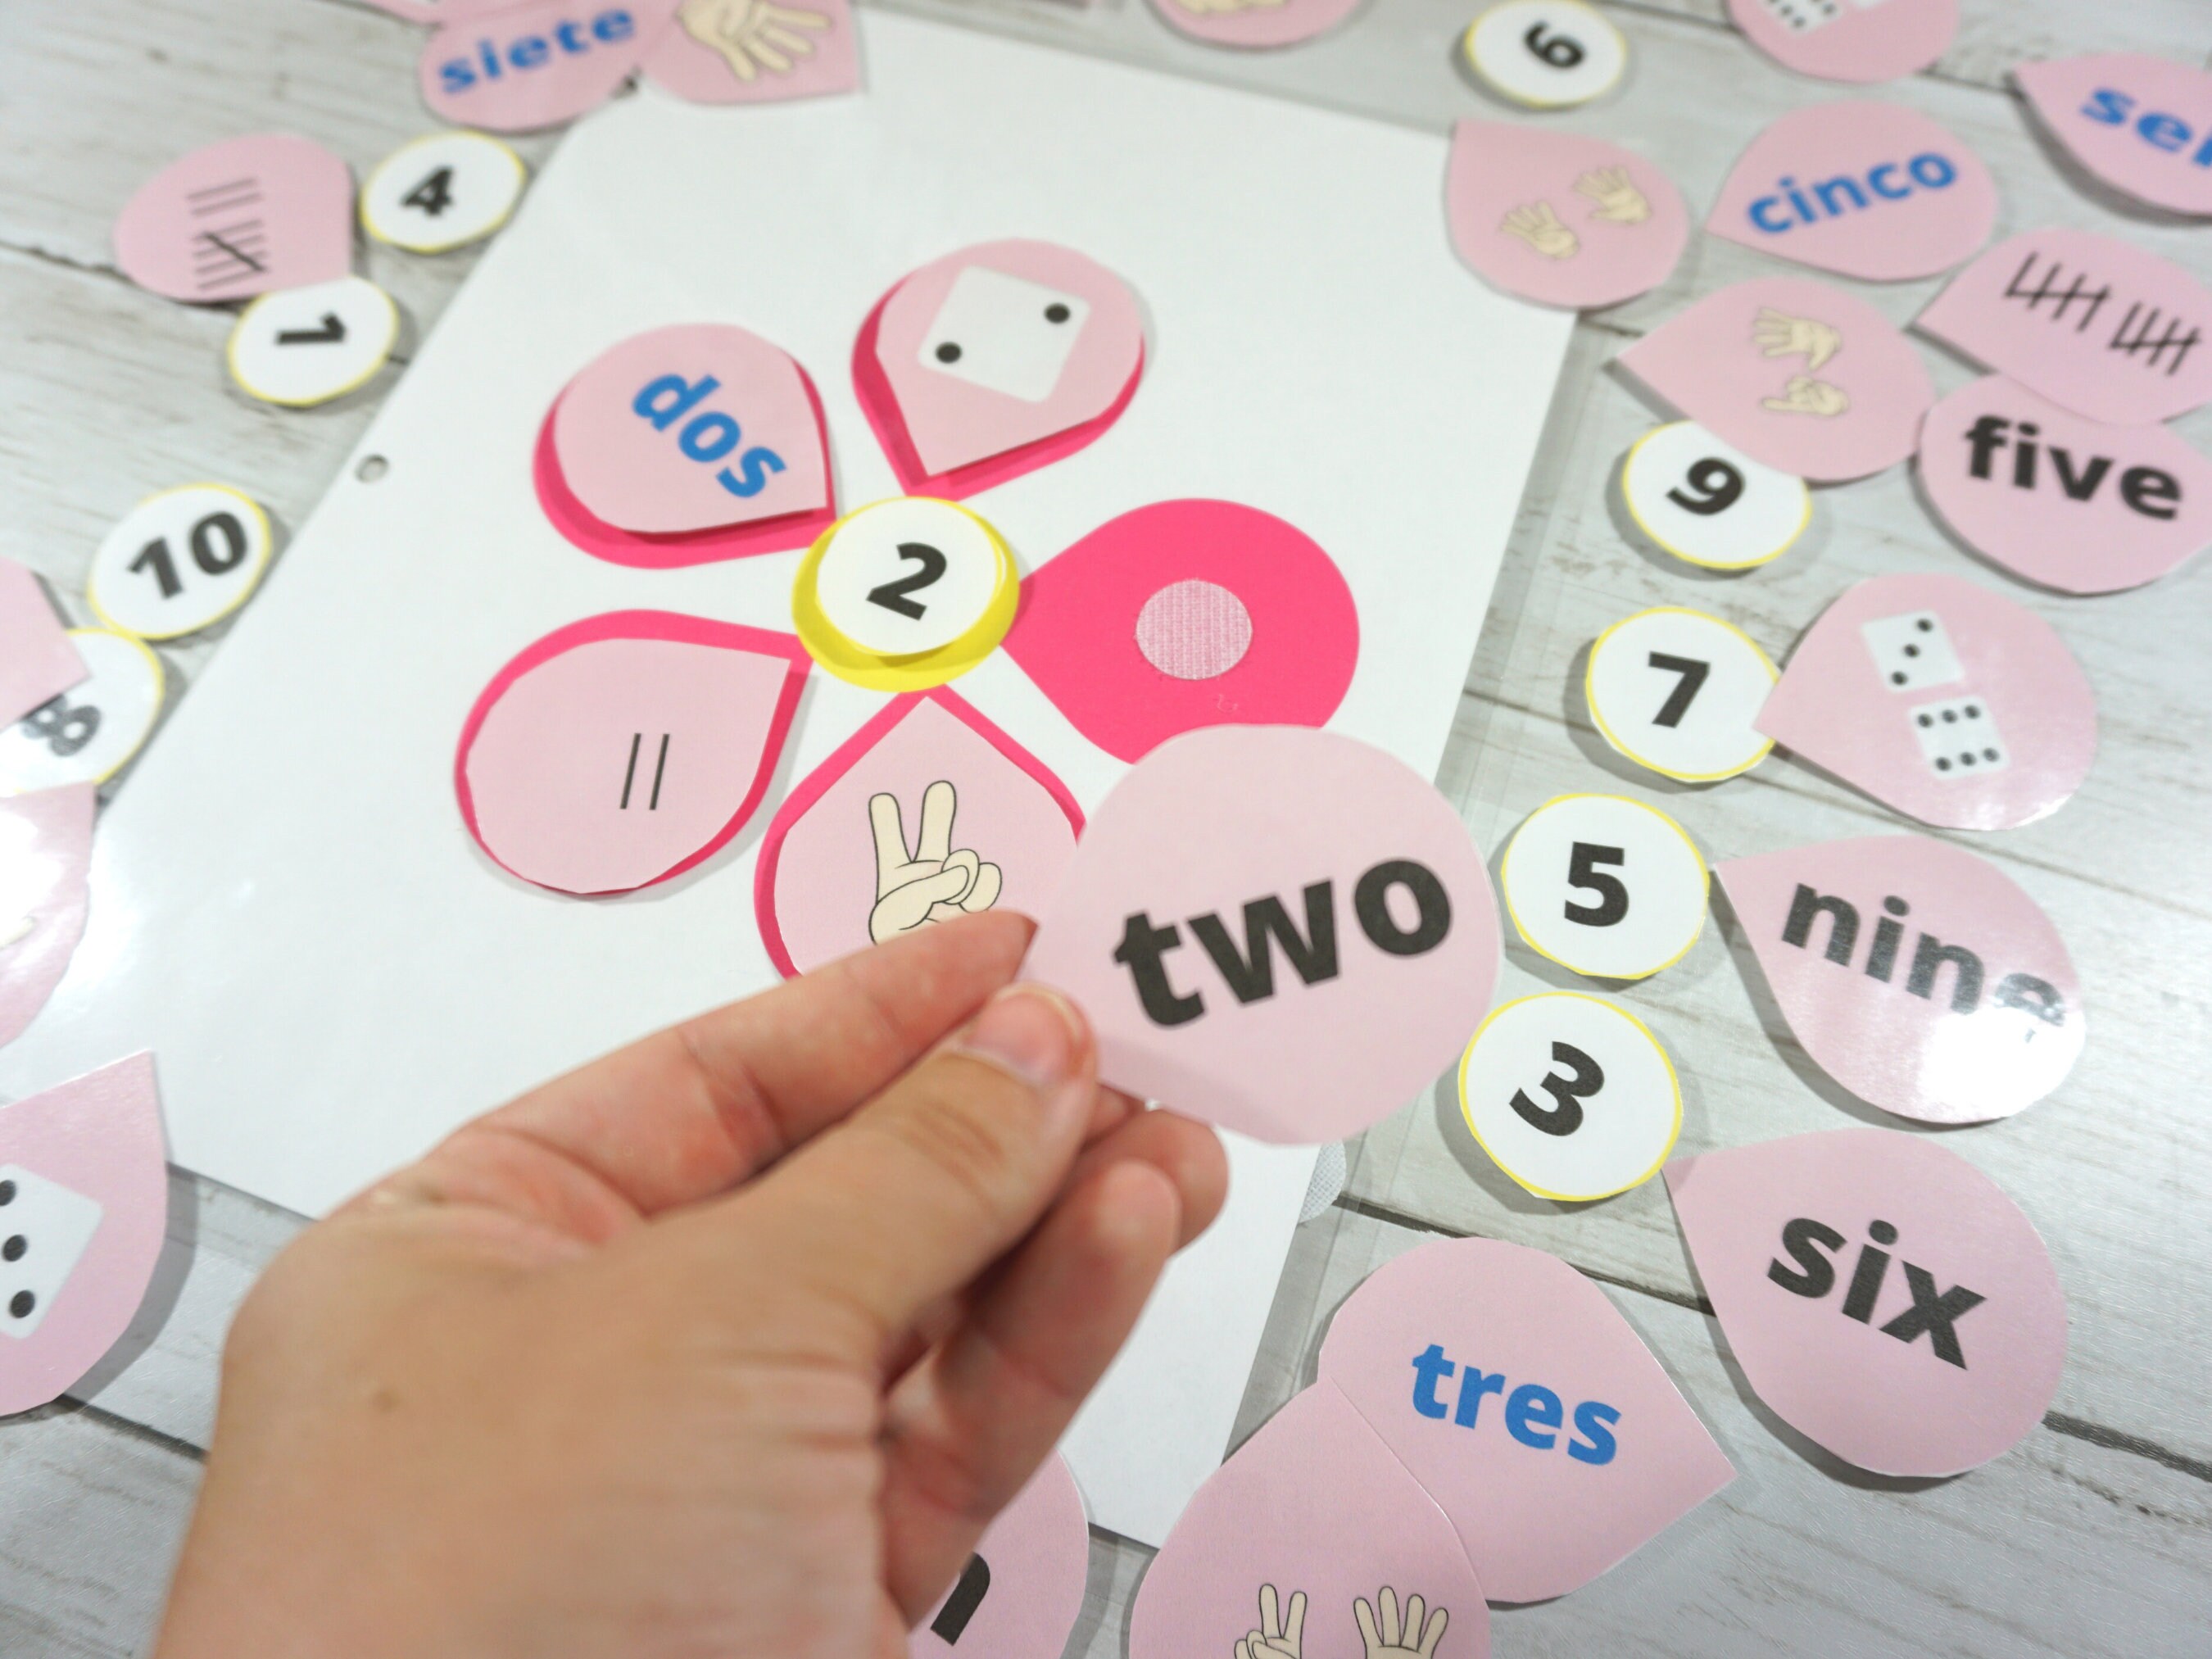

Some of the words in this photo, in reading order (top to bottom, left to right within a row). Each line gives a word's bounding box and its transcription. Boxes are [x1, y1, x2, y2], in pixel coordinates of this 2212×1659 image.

[437, 7, 636, 94] siete
[1523, 21, 1586, 70] 6
[400, 165, 456, 219] 4
[1746, 151, 1957, 235] cinco
[275, 313, 347, 347] 1
[632, 373, 787, 499] dos
[1962, 413, 2183, 522] five
[1666, 456, 1746, 517] 9
[129, 510, 248, 599] 10
[866, 542, 948, 622] 2
[20, 693, 102, 758] 8
[1648, 651, 1711, 729] 7
[1563, 841, 1630, 929] 5
[1113, 859, 1453, 1028] two
[1781, 882, 2065, 1043] nine
[1509, 1040, 1606, 1137] 3
[1766, 1217, 1987, 1371] six
[1411, 1344, 1621, 1466] tres
